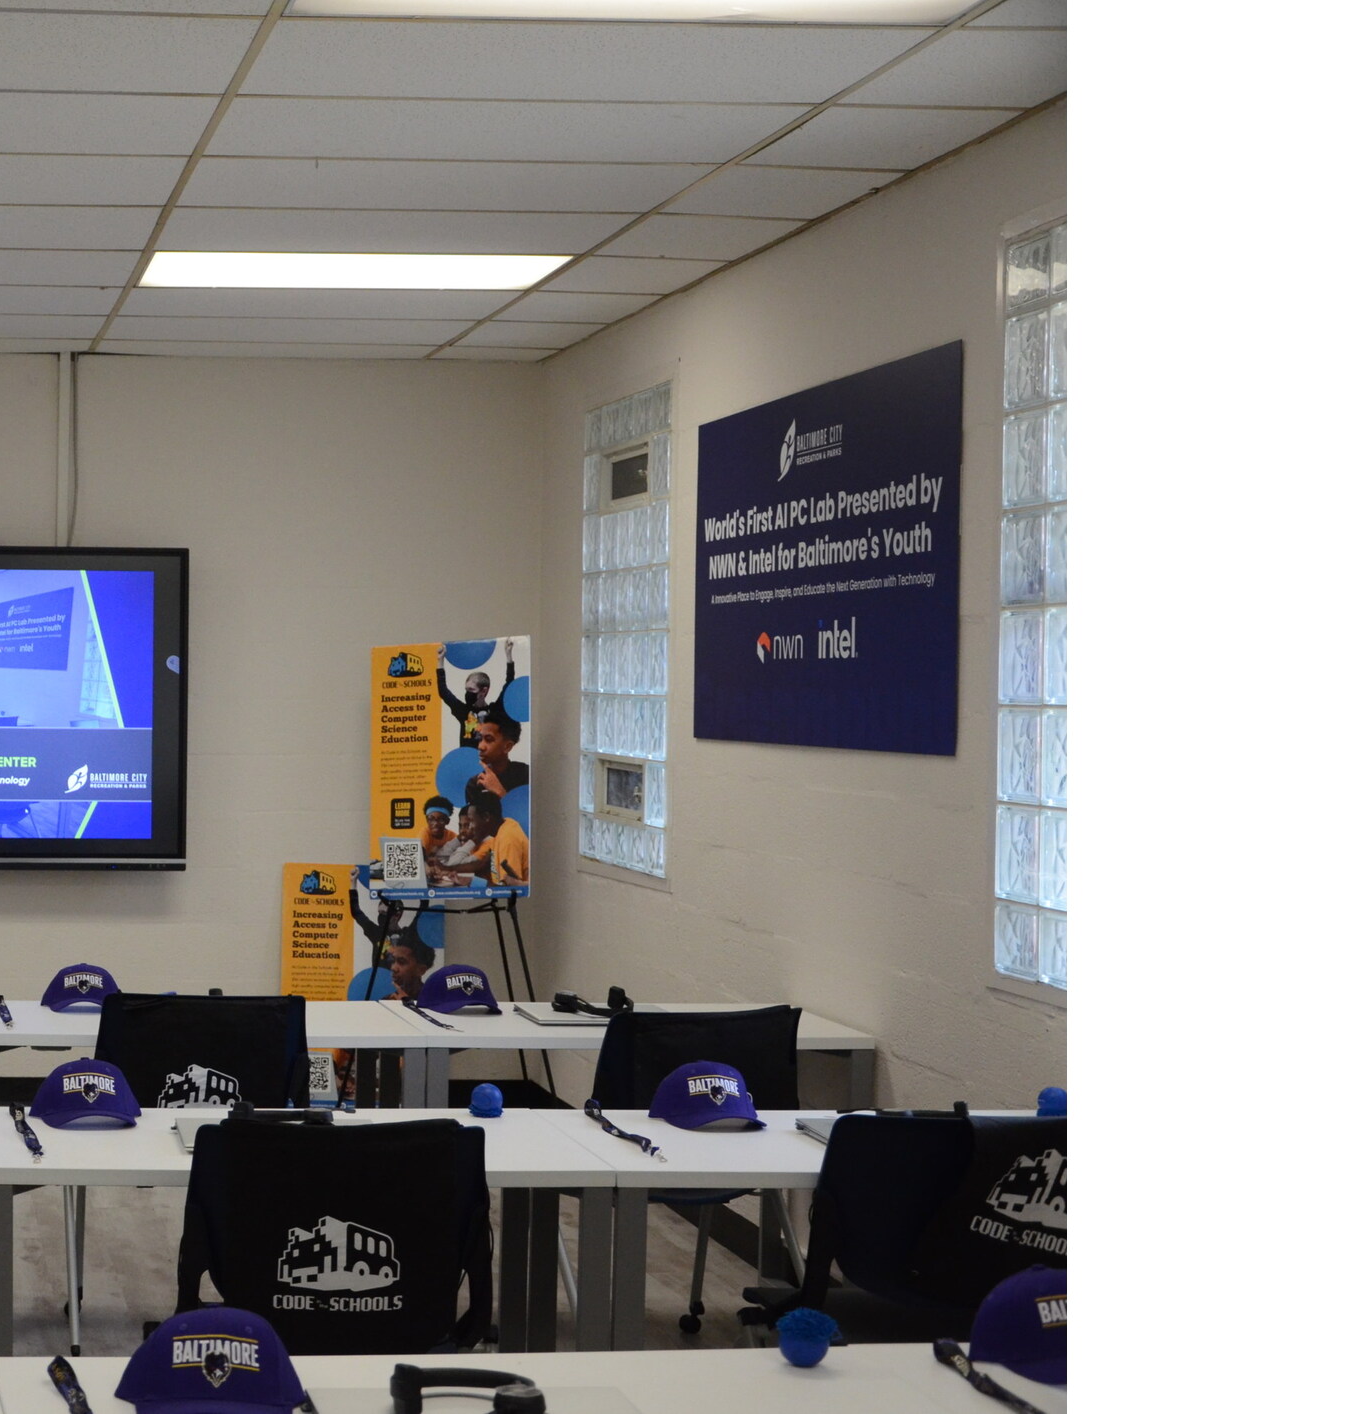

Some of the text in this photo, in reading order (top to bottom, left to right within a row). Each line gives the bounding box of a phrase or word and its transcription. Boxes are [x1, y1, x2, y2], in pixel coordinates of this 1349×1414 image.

[797, 424, 843, 452] BALTIMORE CITY
[797, 452, 822, 465] RECREATION
[827, 447, 841, 458] PARKS
[704, 473, 943, 542] World's First AI PC Lab Presented by
[709, 521, 932, 580] NWN & Intel for Baltimore's Youth
[737, 592, 749, 602] Place
[755, 590, 774, 603] Engage,
[774, 586, 792, 600] Inspire,
[793, 585, 803, 596] and
[804, 584, 825, 595] Educate
[826, 582, 835, 593] the
[836, 581, 848, 592] Next
[850, 577, 882, 591] Generation
[883, 575, 896, 587] with
[898, 572, 935, 587] Technology
[773, 635, 803, 659] nwn
[382, 681, 397, 689] CODE
[403, 679, 432, 688] SCHOOLS
[381, 693, 431, 702] Increasing
[381, 705, 414, 713] Access
[381, 715, 426, 724] Computer
[381, 725, 418, 733] Science
[381, 734, 428, 743] Education
[90, 773, 147, 782] BALTIMORE CITY
[293, 910, 343, 921] Increasing
[293, 931, 338, 940] Computer
[292, 940, 329, 948] Science
[292, 950, 340, 959] Education
[64, 974, 103, 987] BALTIMORE
[446, 976, 483, 988] BALTIMORE
[63, 1075, 116, 1093] BALTIMORE
[689, 1077, 740, 1095] BALTIMORE
[970, 1215, 1013, 1242] CODE
[1019, 1229, 1067, 1256] SCHOO
[273, 1294, 315, 1310] CODE
[330, 1295, 403, 1312] SCHOOLS
[1037, 1299, 1067, 1323] BAL
[173, 1339, 260, 1367] BALTIMORE
